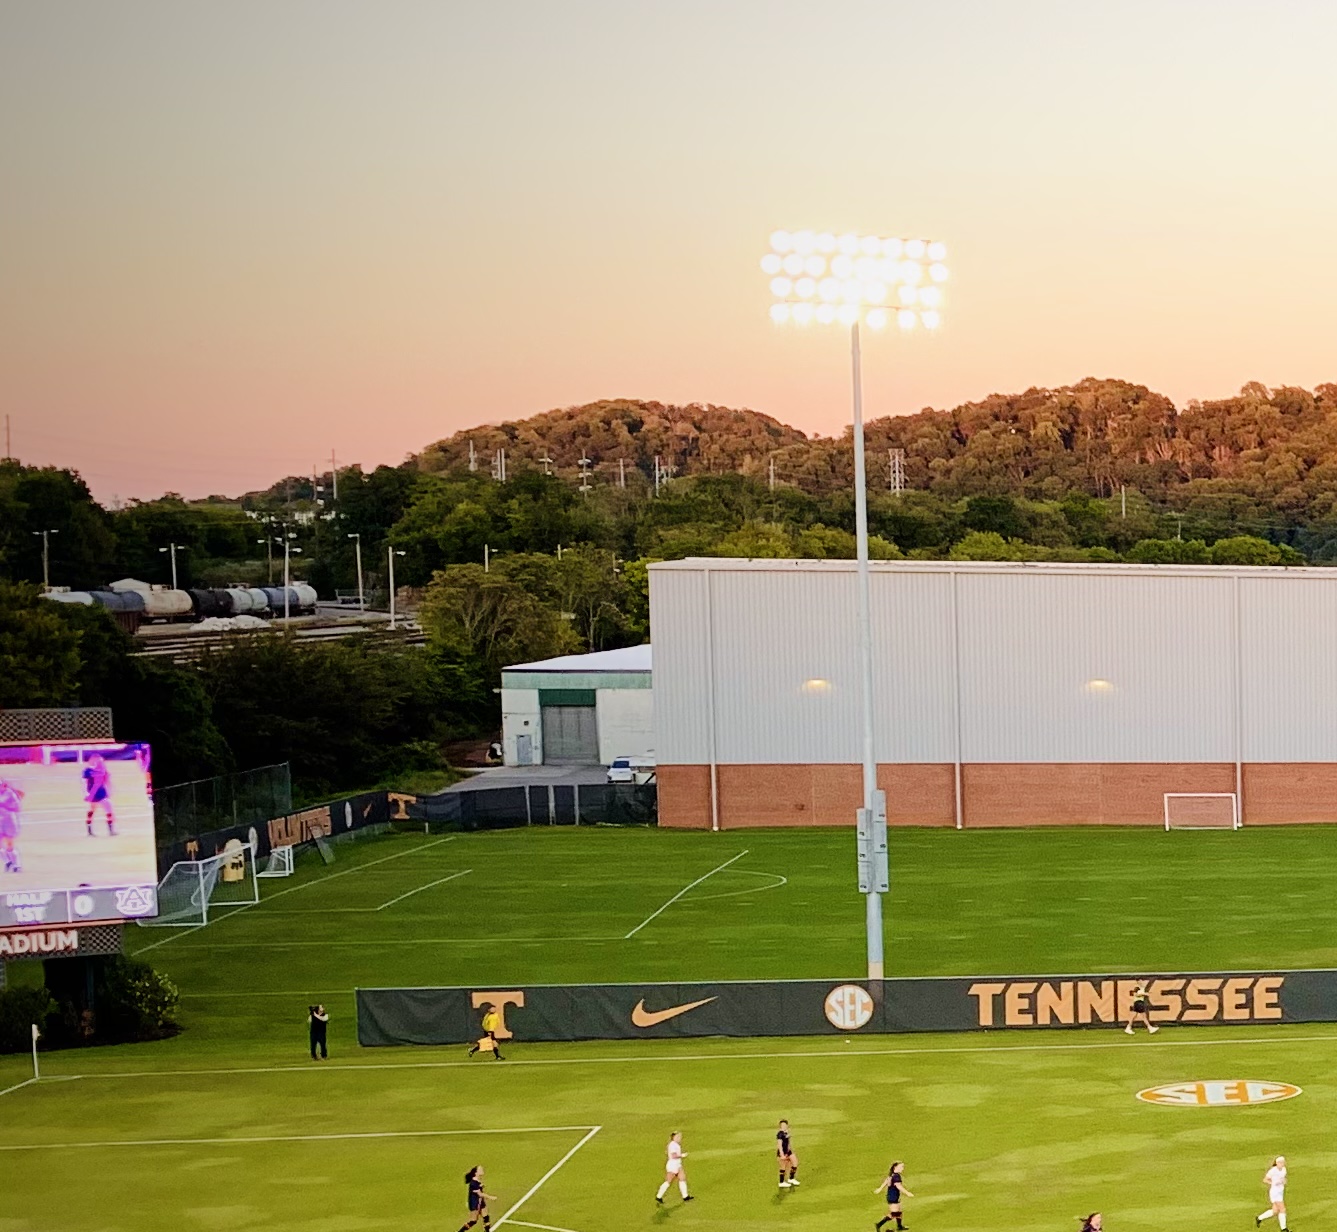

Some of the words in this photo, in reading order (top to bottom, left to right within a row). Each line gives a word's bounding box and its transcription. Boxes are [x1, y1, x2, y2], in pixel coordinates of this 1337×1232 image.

[828, 986, 872, 1028] SEC
[968, 977, 1284, 1026] TENNESSEE
[1146, 1081, 1293, 1105] SEC
